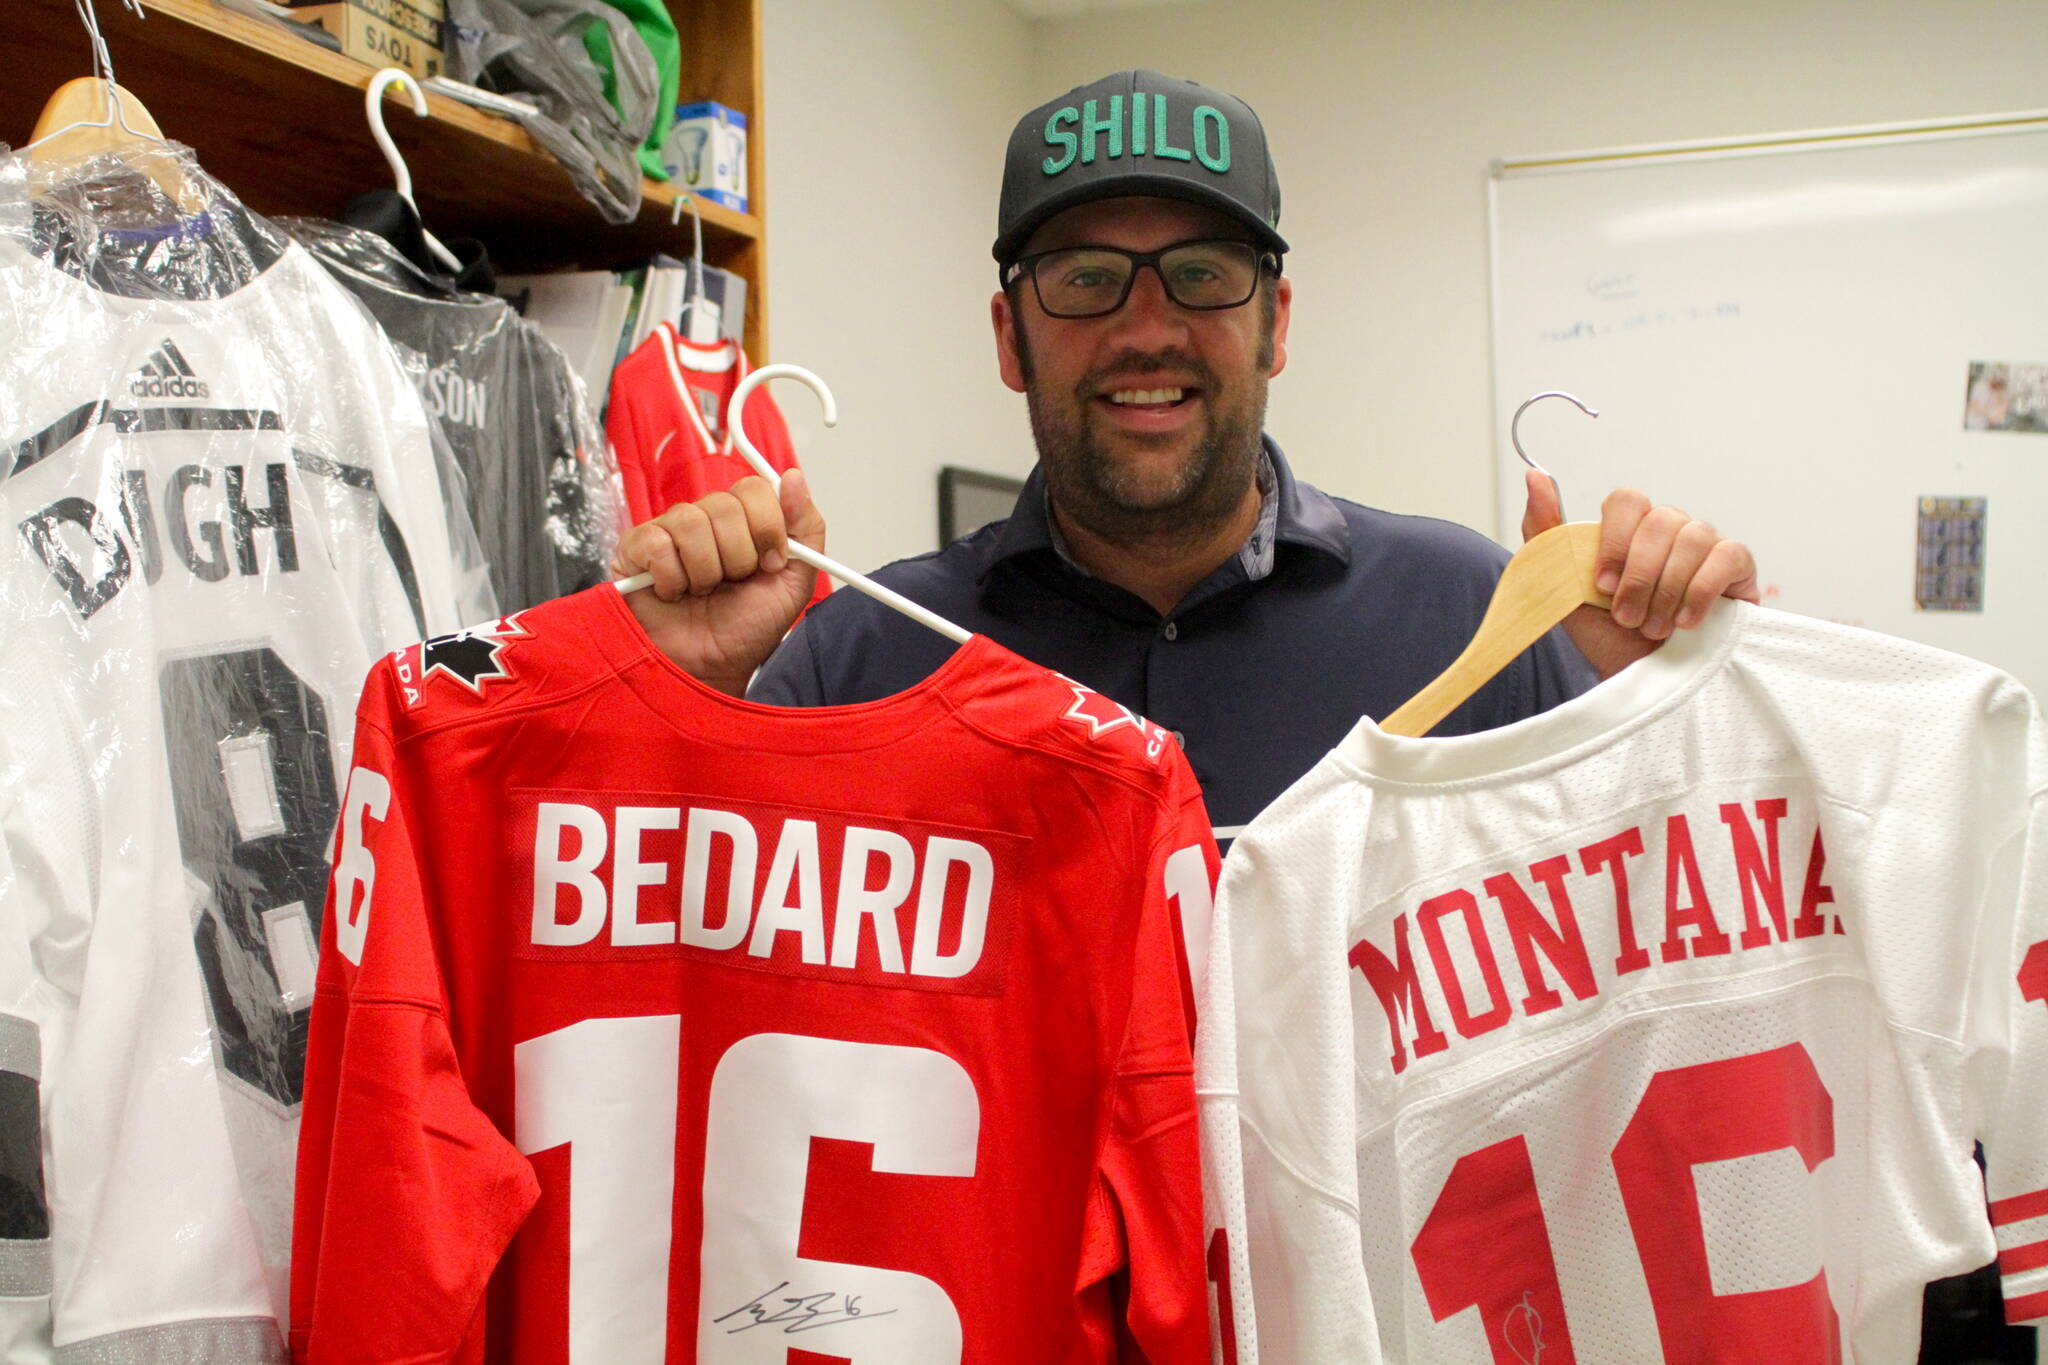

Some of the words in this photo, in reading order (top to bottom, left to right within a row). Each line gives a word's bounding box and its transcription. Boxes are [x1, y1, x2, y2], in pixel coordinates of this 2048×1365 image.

[365, 26, 413, 68] TOYS
[1042, 92, 1231, 175] SHILO
[131, 374, 210, 398] adidas
[412, 364, 486, 431] SON
[158, 643, 341, 1120] 8
[333, 765, 392, 957] 6
[530, 802, 995, 978] BEDARD
[1348, 797, 1847, 1075] MONTANA
[514, 1014, 981, 1365] 16
[1410, 1041, 1842, 1365] 16
